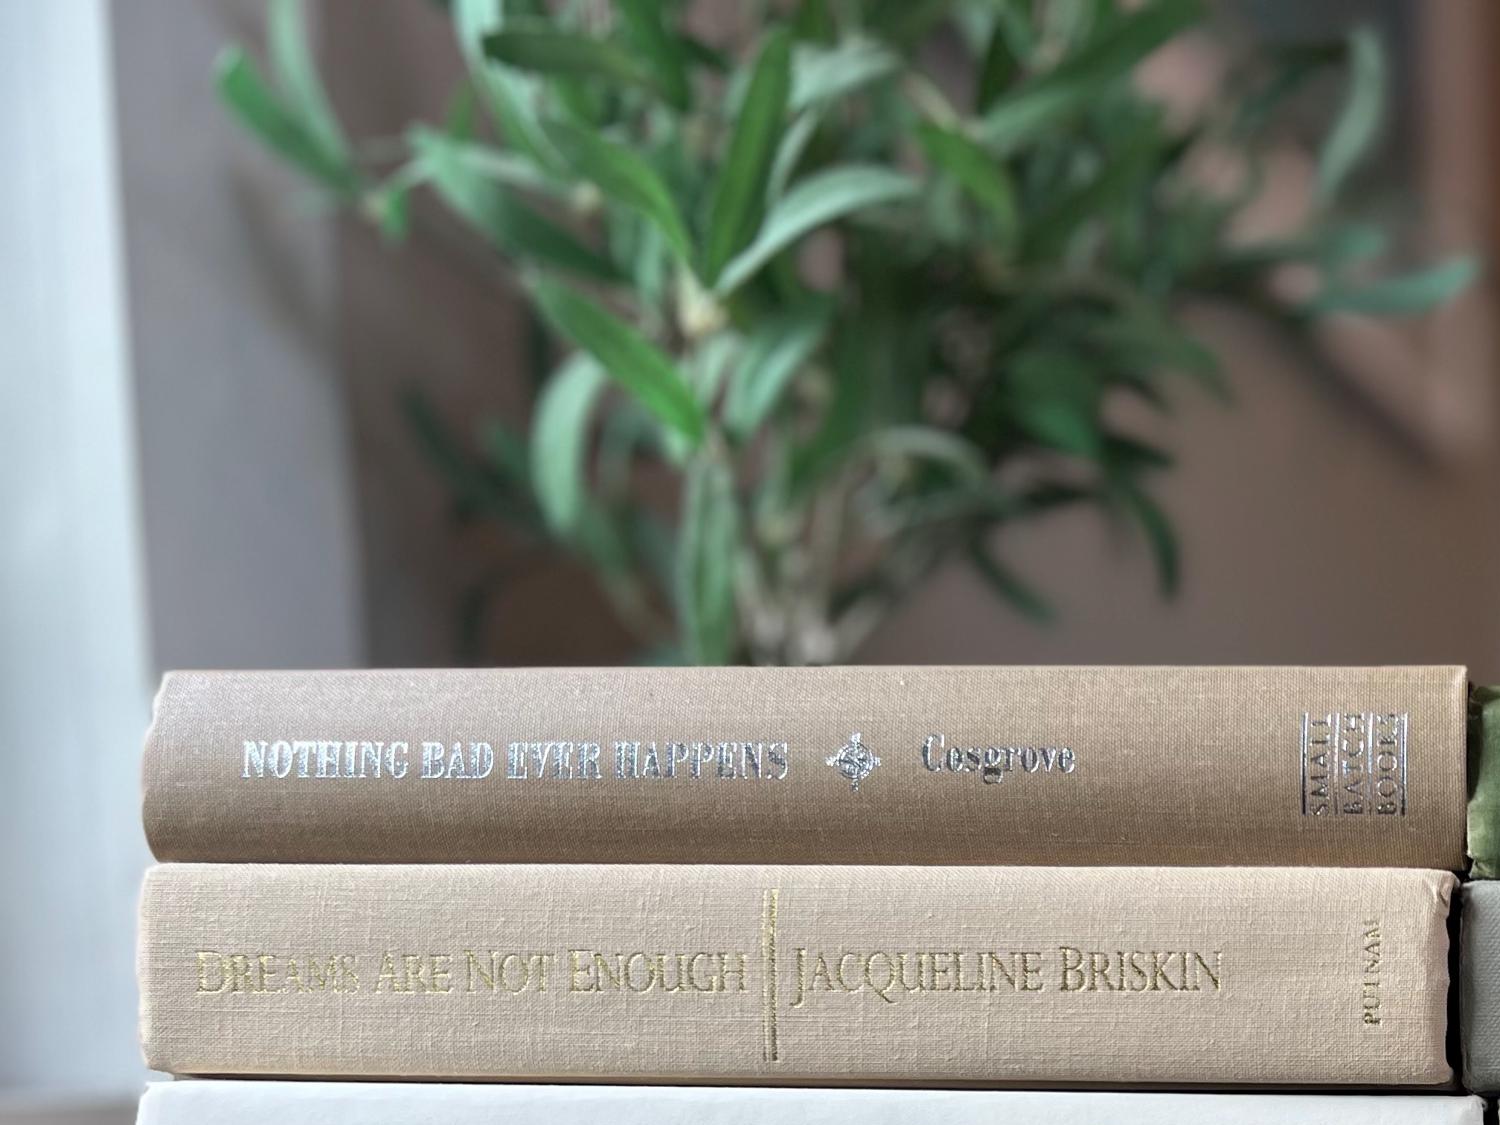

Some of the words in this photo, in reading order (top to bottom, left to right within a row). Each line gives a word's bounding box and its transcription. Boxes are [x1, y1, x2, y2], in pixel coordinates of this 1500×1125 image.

[242, 740, 409, 779] NOTHING
[421, 740, 495, 779] BAD
[507, 740, 603, 779] EVER
[615, 740, 789, 779] HAPPENS
[922, 734, 1076, 785] Cosgrove
[1309, 713, 1331, 816] SMALL
[1343, 712, 1364, 815] BATCH
[1377, 713, 1398, 815] BOOKS
[464, 948, 557, 996] NOT
[1362, 920, 1381, 1025] PUTNAM
